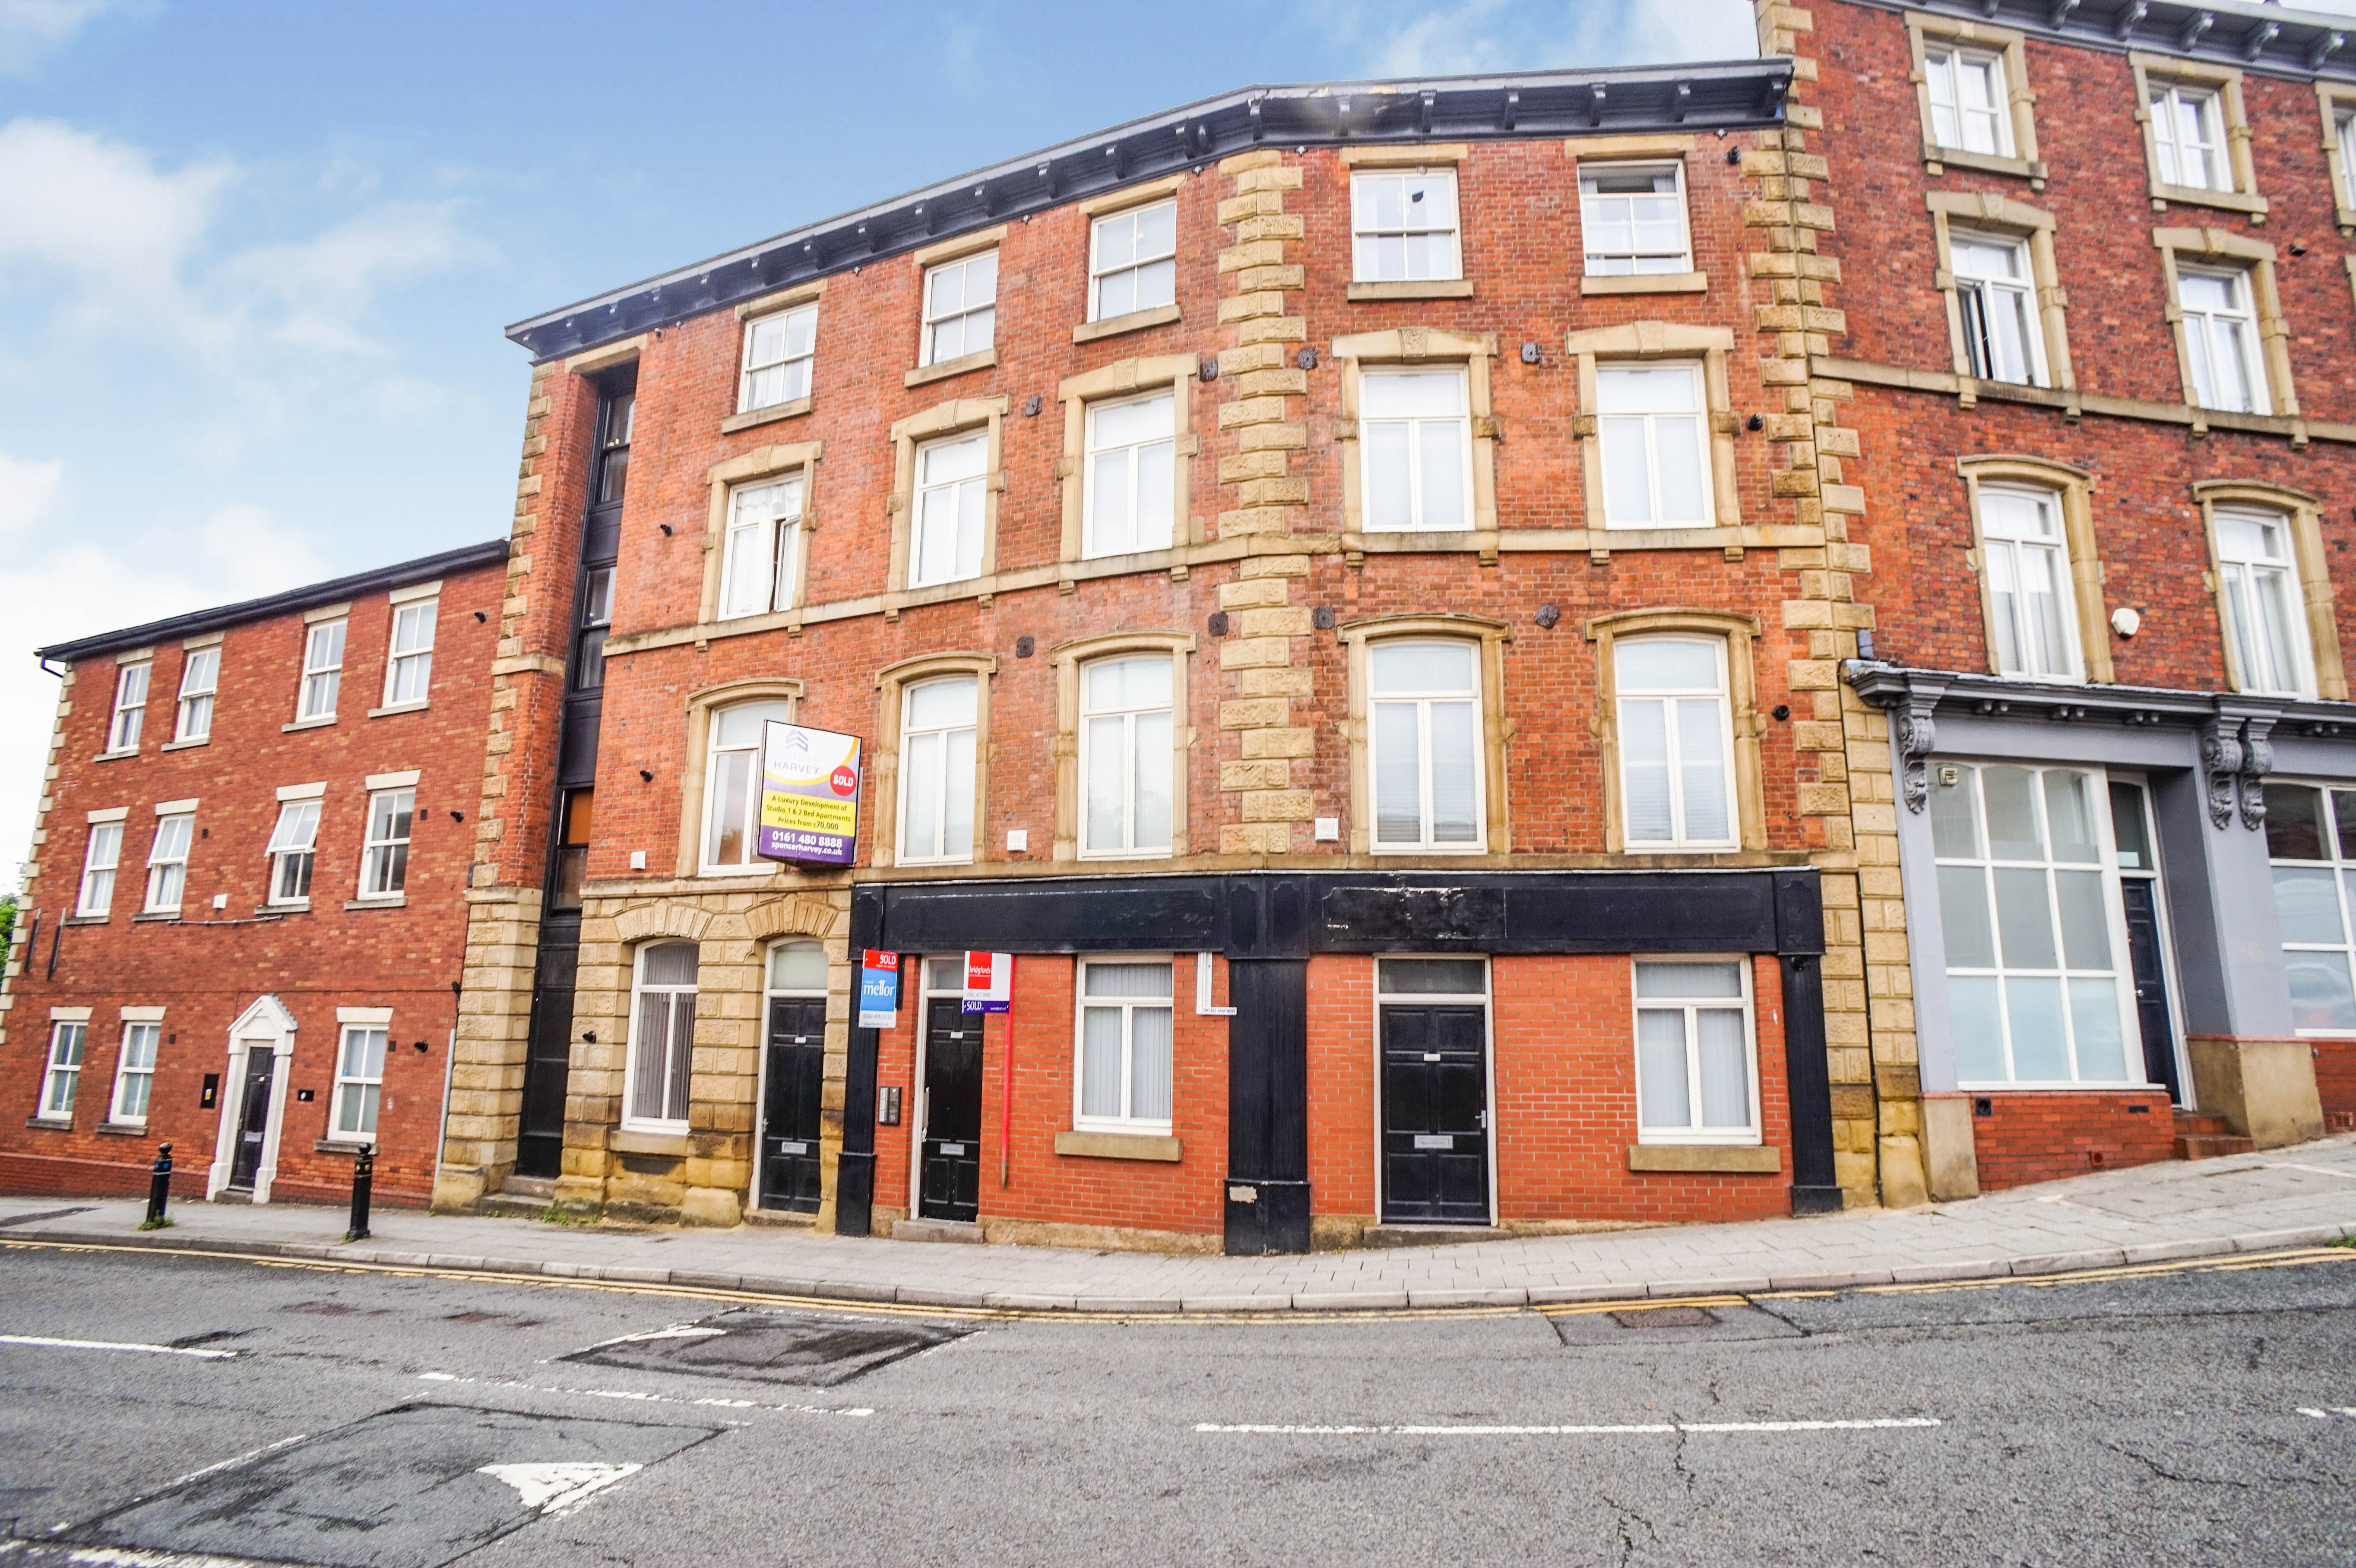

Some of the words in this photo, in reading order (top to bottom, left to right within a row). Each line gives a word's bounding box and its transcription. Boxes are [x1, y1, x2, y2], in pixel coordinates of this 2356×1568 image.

[774, 760, 819, 775] HARVEY
[833, 774, 854, 787] SOLD
[778, 796, 799, 806] Luxury
[801, 799, 839, 810] Development
[778, 816, 796, 825] Prices
[798, 819, 812, 827] from
[814, 821, 839, 830] £70,000
[816, 812, 851, 822] Apartments
[772, 831, 795, 843] 0161
[798, 834, 817, 845] 480
[819, 836, 843, 848] 8888
[771, 841, 843, 856] spencerharvey.co.uk
[880, 954, 896, 965] SOLD
[969, 965, 991, 975] bridgfords
[863, 979, 895, 997] mellor
[966, 1001, 982, 1011] SOLD
